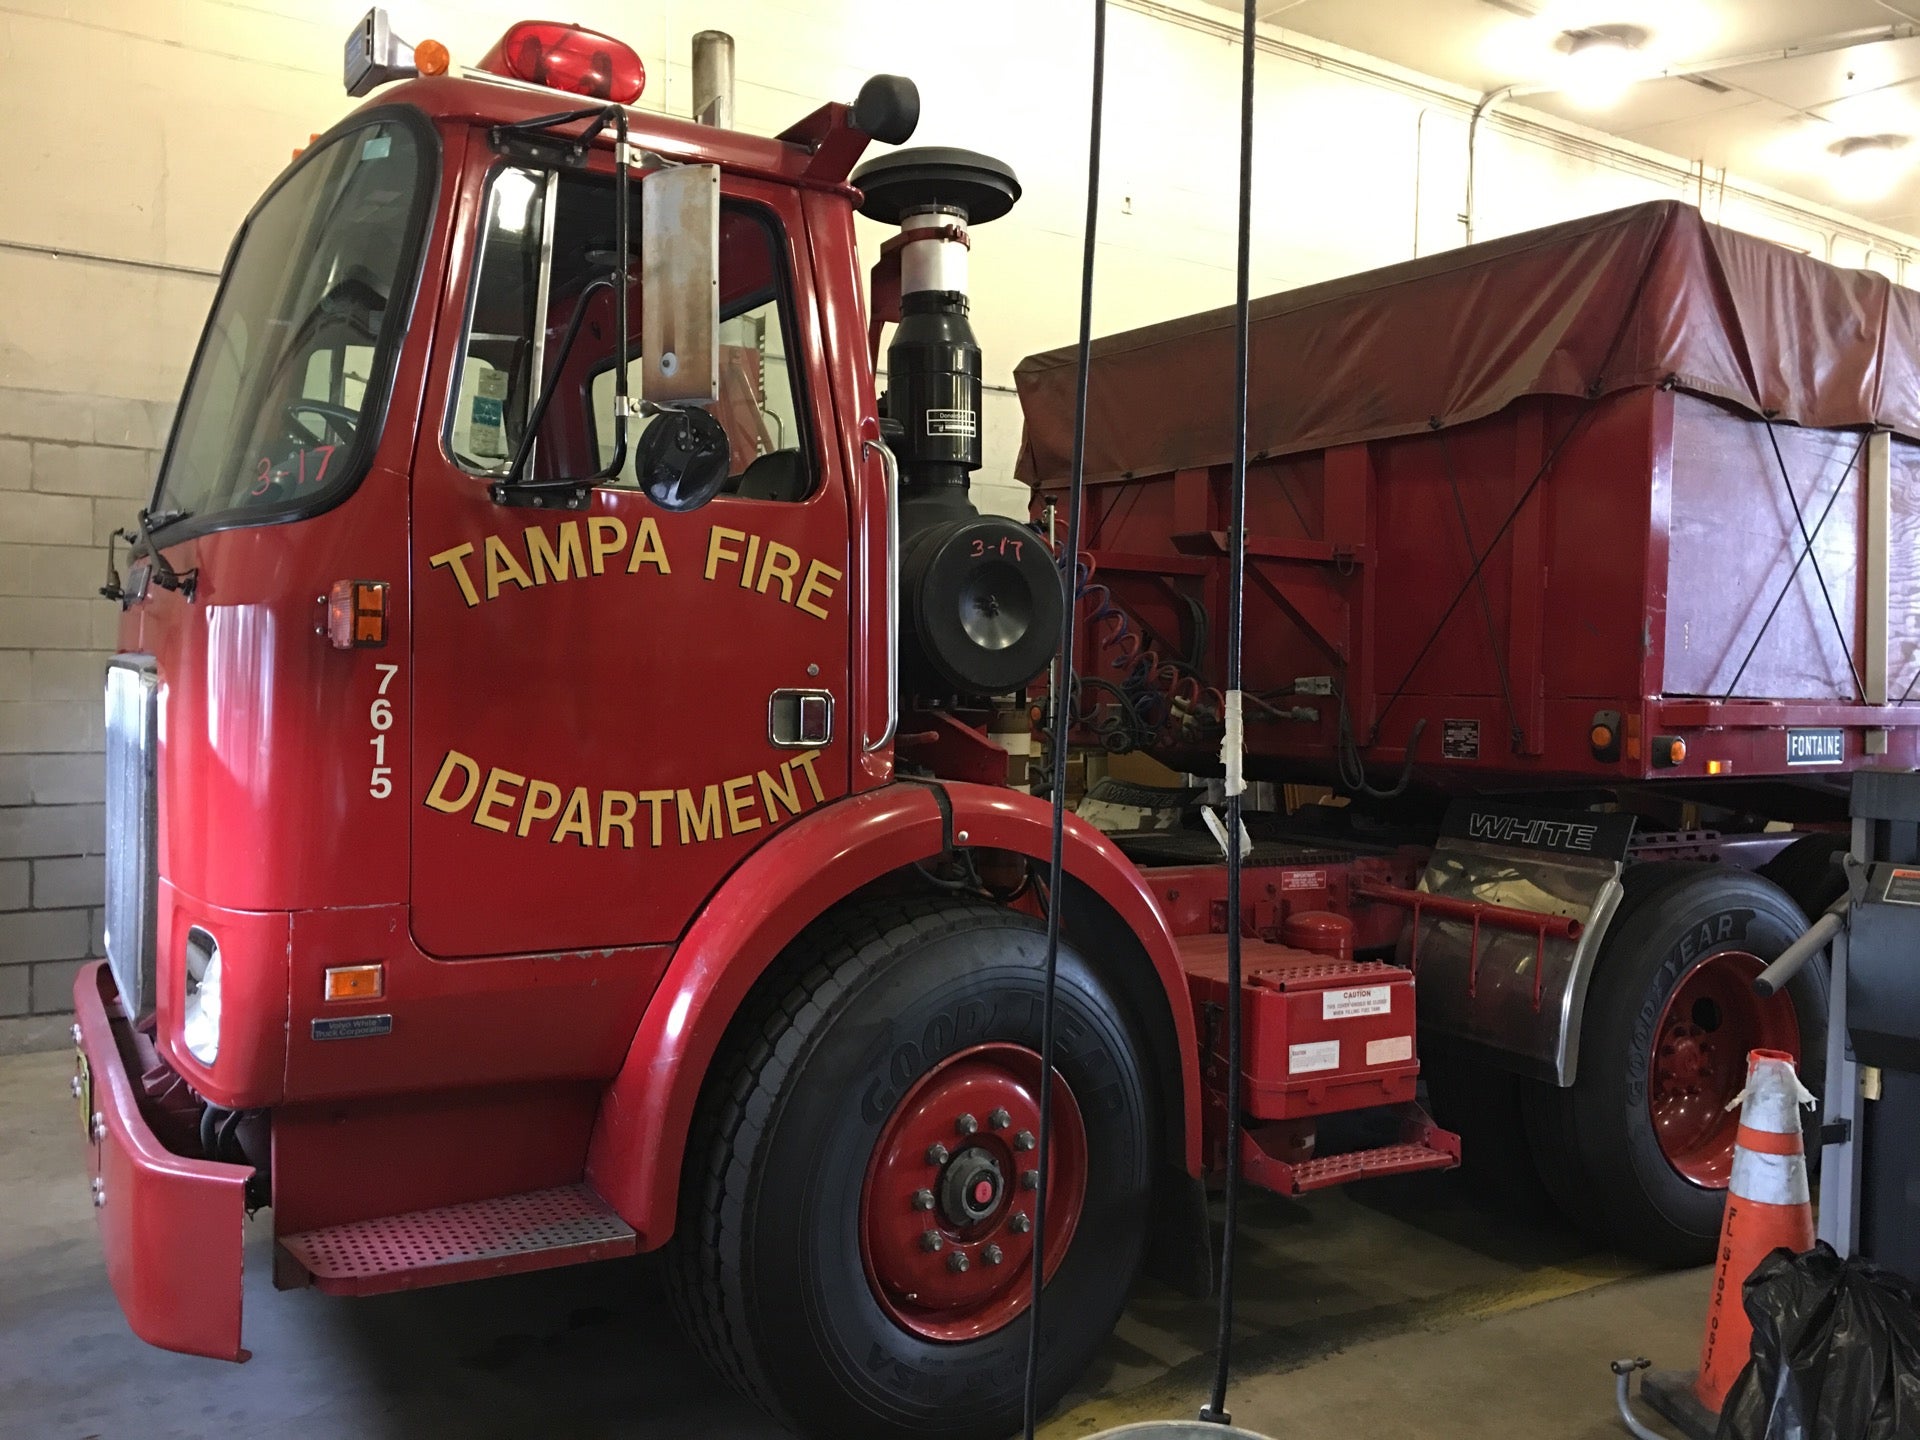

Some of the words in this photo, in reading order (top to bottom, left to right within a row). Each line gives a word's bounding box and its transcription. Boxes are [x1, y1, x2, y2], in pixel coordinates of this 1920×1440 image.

[251, 445, 335, 496] 3-17
[970, 536, 1023, 562] 3-17
[429, 516, 672, 608] TAMPA
[704, 525, 843, 620] FIRE
[369, 663, 399, 800] 7615
[1791, 734, 1841, 758] FONTAINE
[423, 749, 826, 849] DEPARTMENT
[1468, 812, 1598, 851] WHITE
[1343, 990, 1372, 999] CAUTION
[315, 1030, 339, 1038] Truck
[339, 1026, 390, 1038] Corporation
[329, 1022, 351, 1030] Volvo
[352, 1019, 377, 1028] White
